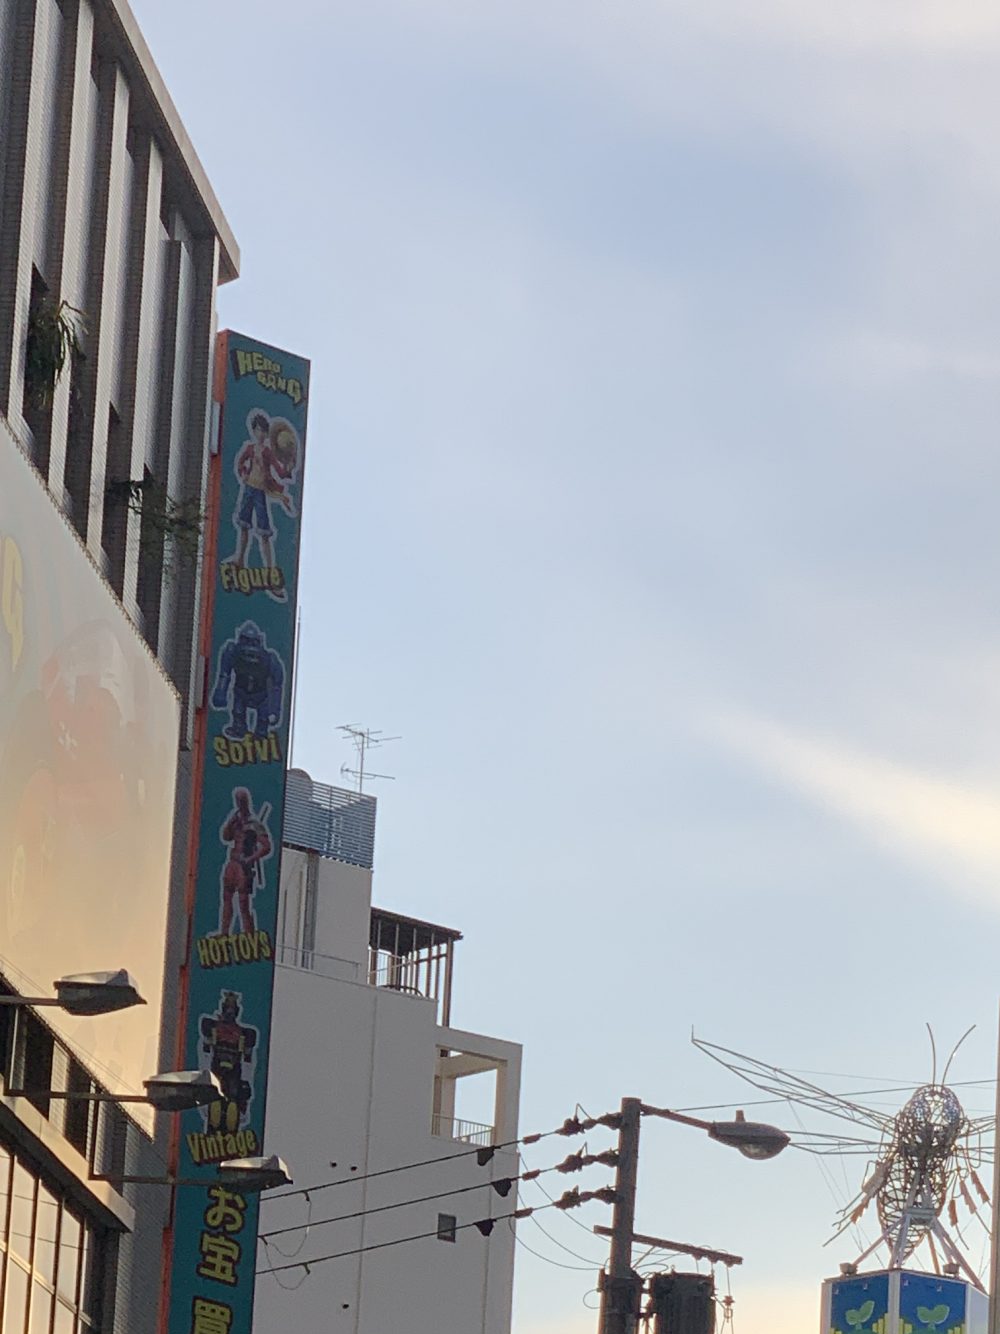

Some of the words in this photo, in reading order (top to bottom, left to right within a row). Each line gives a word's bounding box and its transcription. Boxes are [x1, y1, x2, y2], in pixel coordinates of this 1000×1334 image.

[220, 562, 282, 595] Figure
[213, 732, 282, 768] Sofvi
[186, 1130, 257, 1164] Vintage
[198, 1186, 247, 1285] お宝
